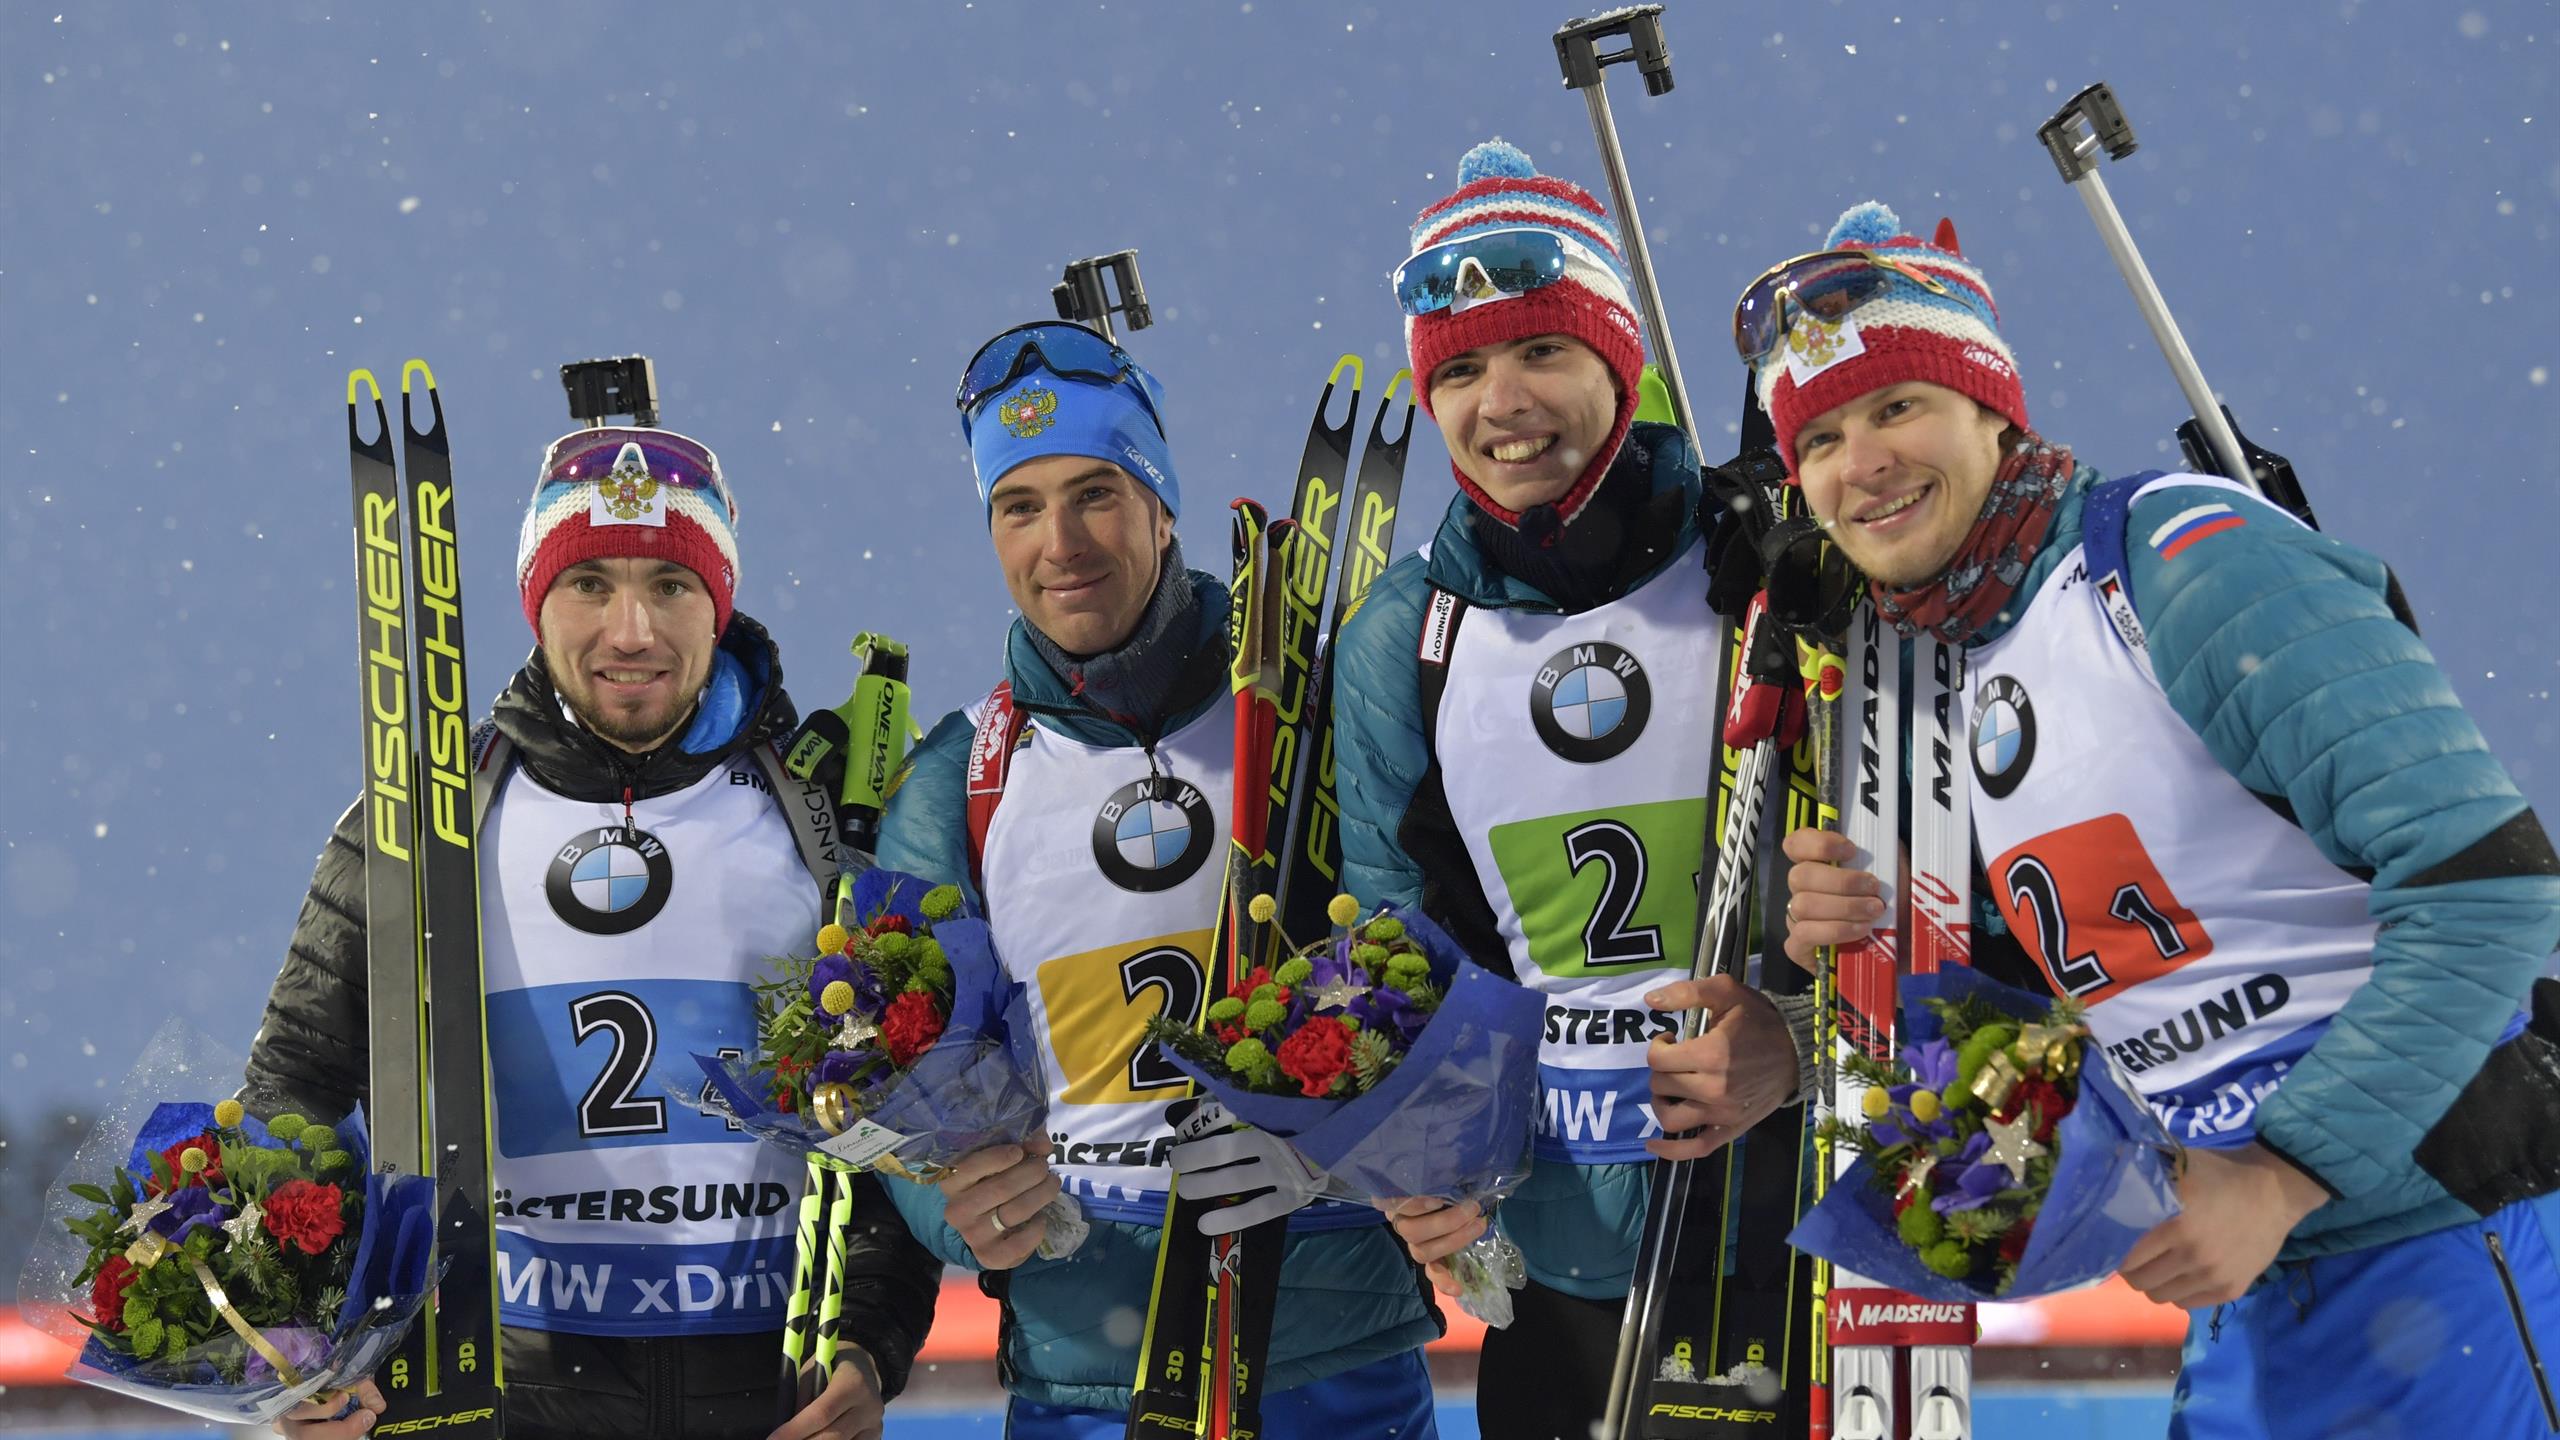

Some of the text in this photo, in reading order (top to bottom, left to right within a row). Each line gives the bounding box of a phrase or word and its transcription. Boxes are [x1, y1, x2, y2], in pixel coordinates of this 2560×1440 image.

[1232, 597, 1243, 650] LEKI
[1433, 594, 1451, 658] ASHNIKOV
[364, 493, 410, 862] FISCHER
[417, 480, 468, 849] FISCHER
[1252, 477, 1342, 869] ISCHER
[1538, 646, 1638, 690] BMW
[1101, 781, 1200, 823] BMW
[563, 829, 663, 867] BMW
[1562, 819, 1666, 967] 2
[2005, 853, 2190, 999] 2 1
[1118, 945, 1205, 1092] 2
[1544, 1005, 1686, 1045] STERS
[569, 990, 668, 1138] 2
[1858, 1304, 1966, 1326] MADSHUS
[391, 1359, 409, 1389] 3D
[459, 1343, 476, 1373] 3D
[1166, 1350, 1184, 1382] 3D
[374, 1408, 495, 1437] FISCHER
[1649, 1404, 1777, 1424] FISCHER
